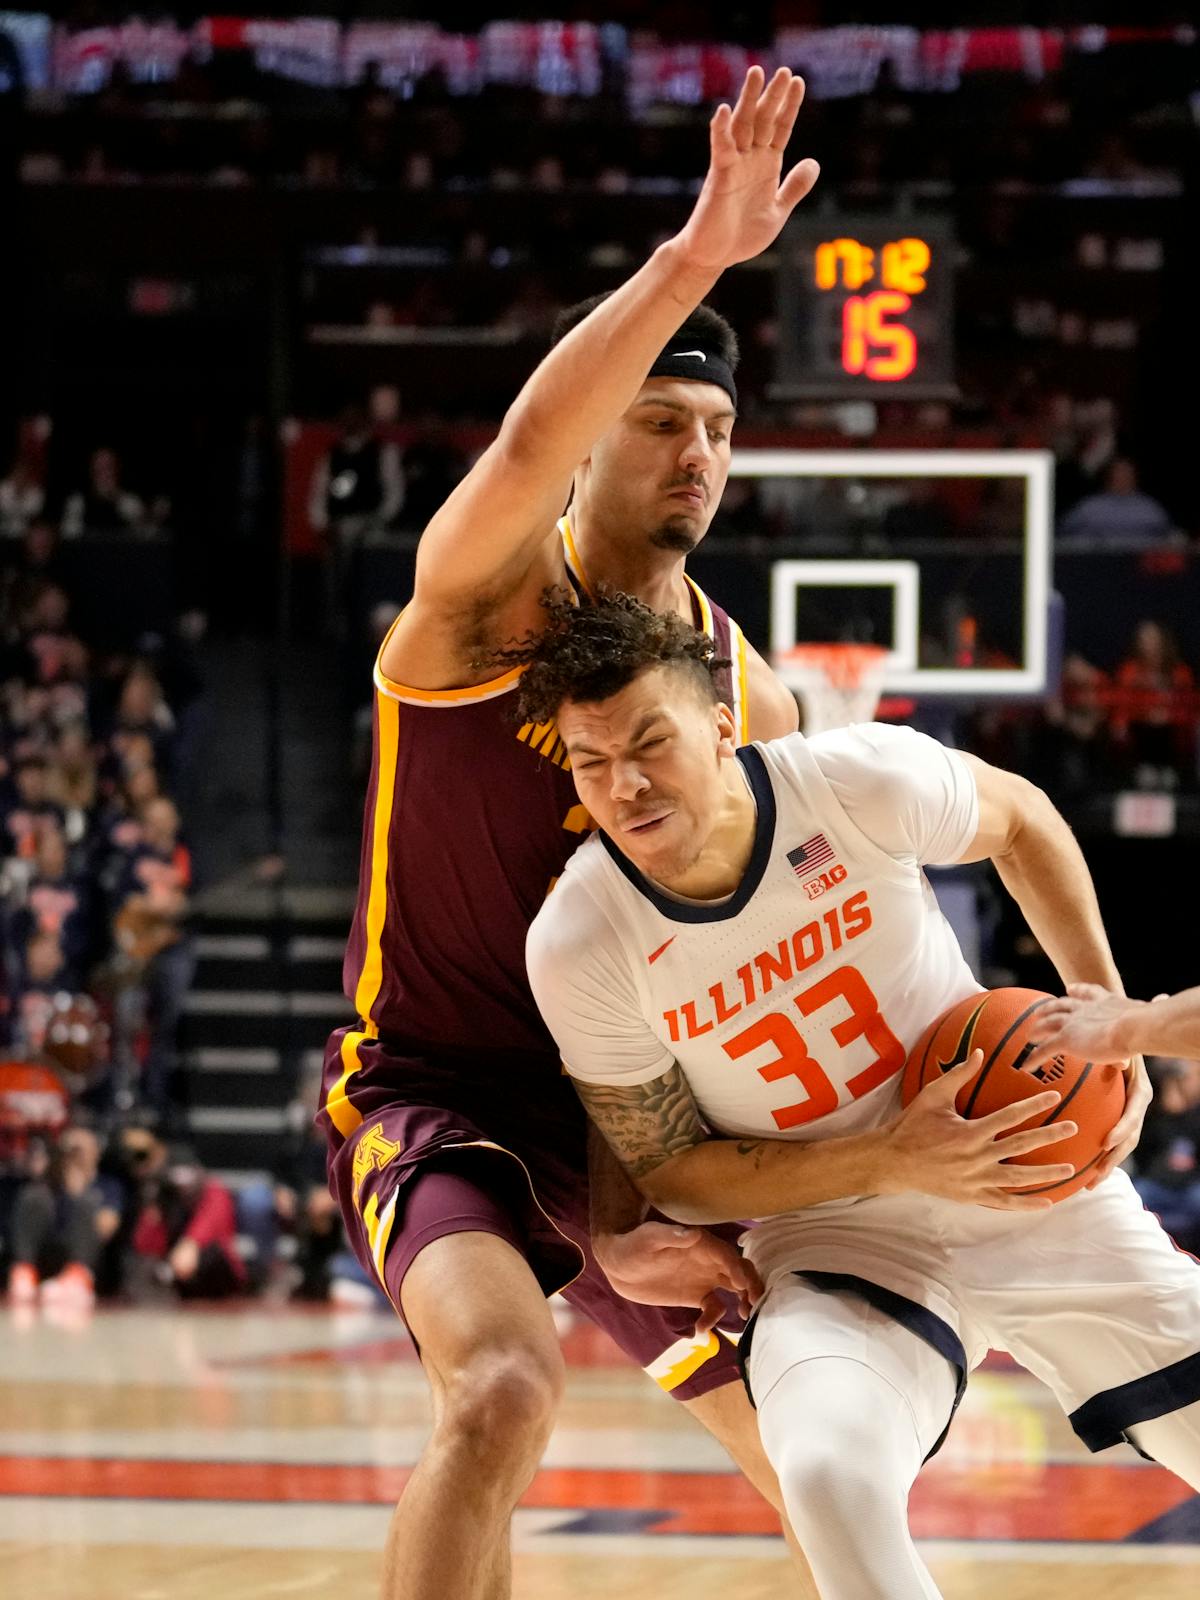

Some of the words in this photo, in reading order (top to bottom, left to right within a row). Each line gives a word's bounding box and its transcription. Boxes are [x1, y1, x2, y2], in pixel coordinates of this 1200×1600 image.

[815, 238, 931, 294] 17:12
[842, 290, 918, 382] 15
[663, 890, 873, 1042] ILLINOIS
[721, 965, 906, 1131] 33
